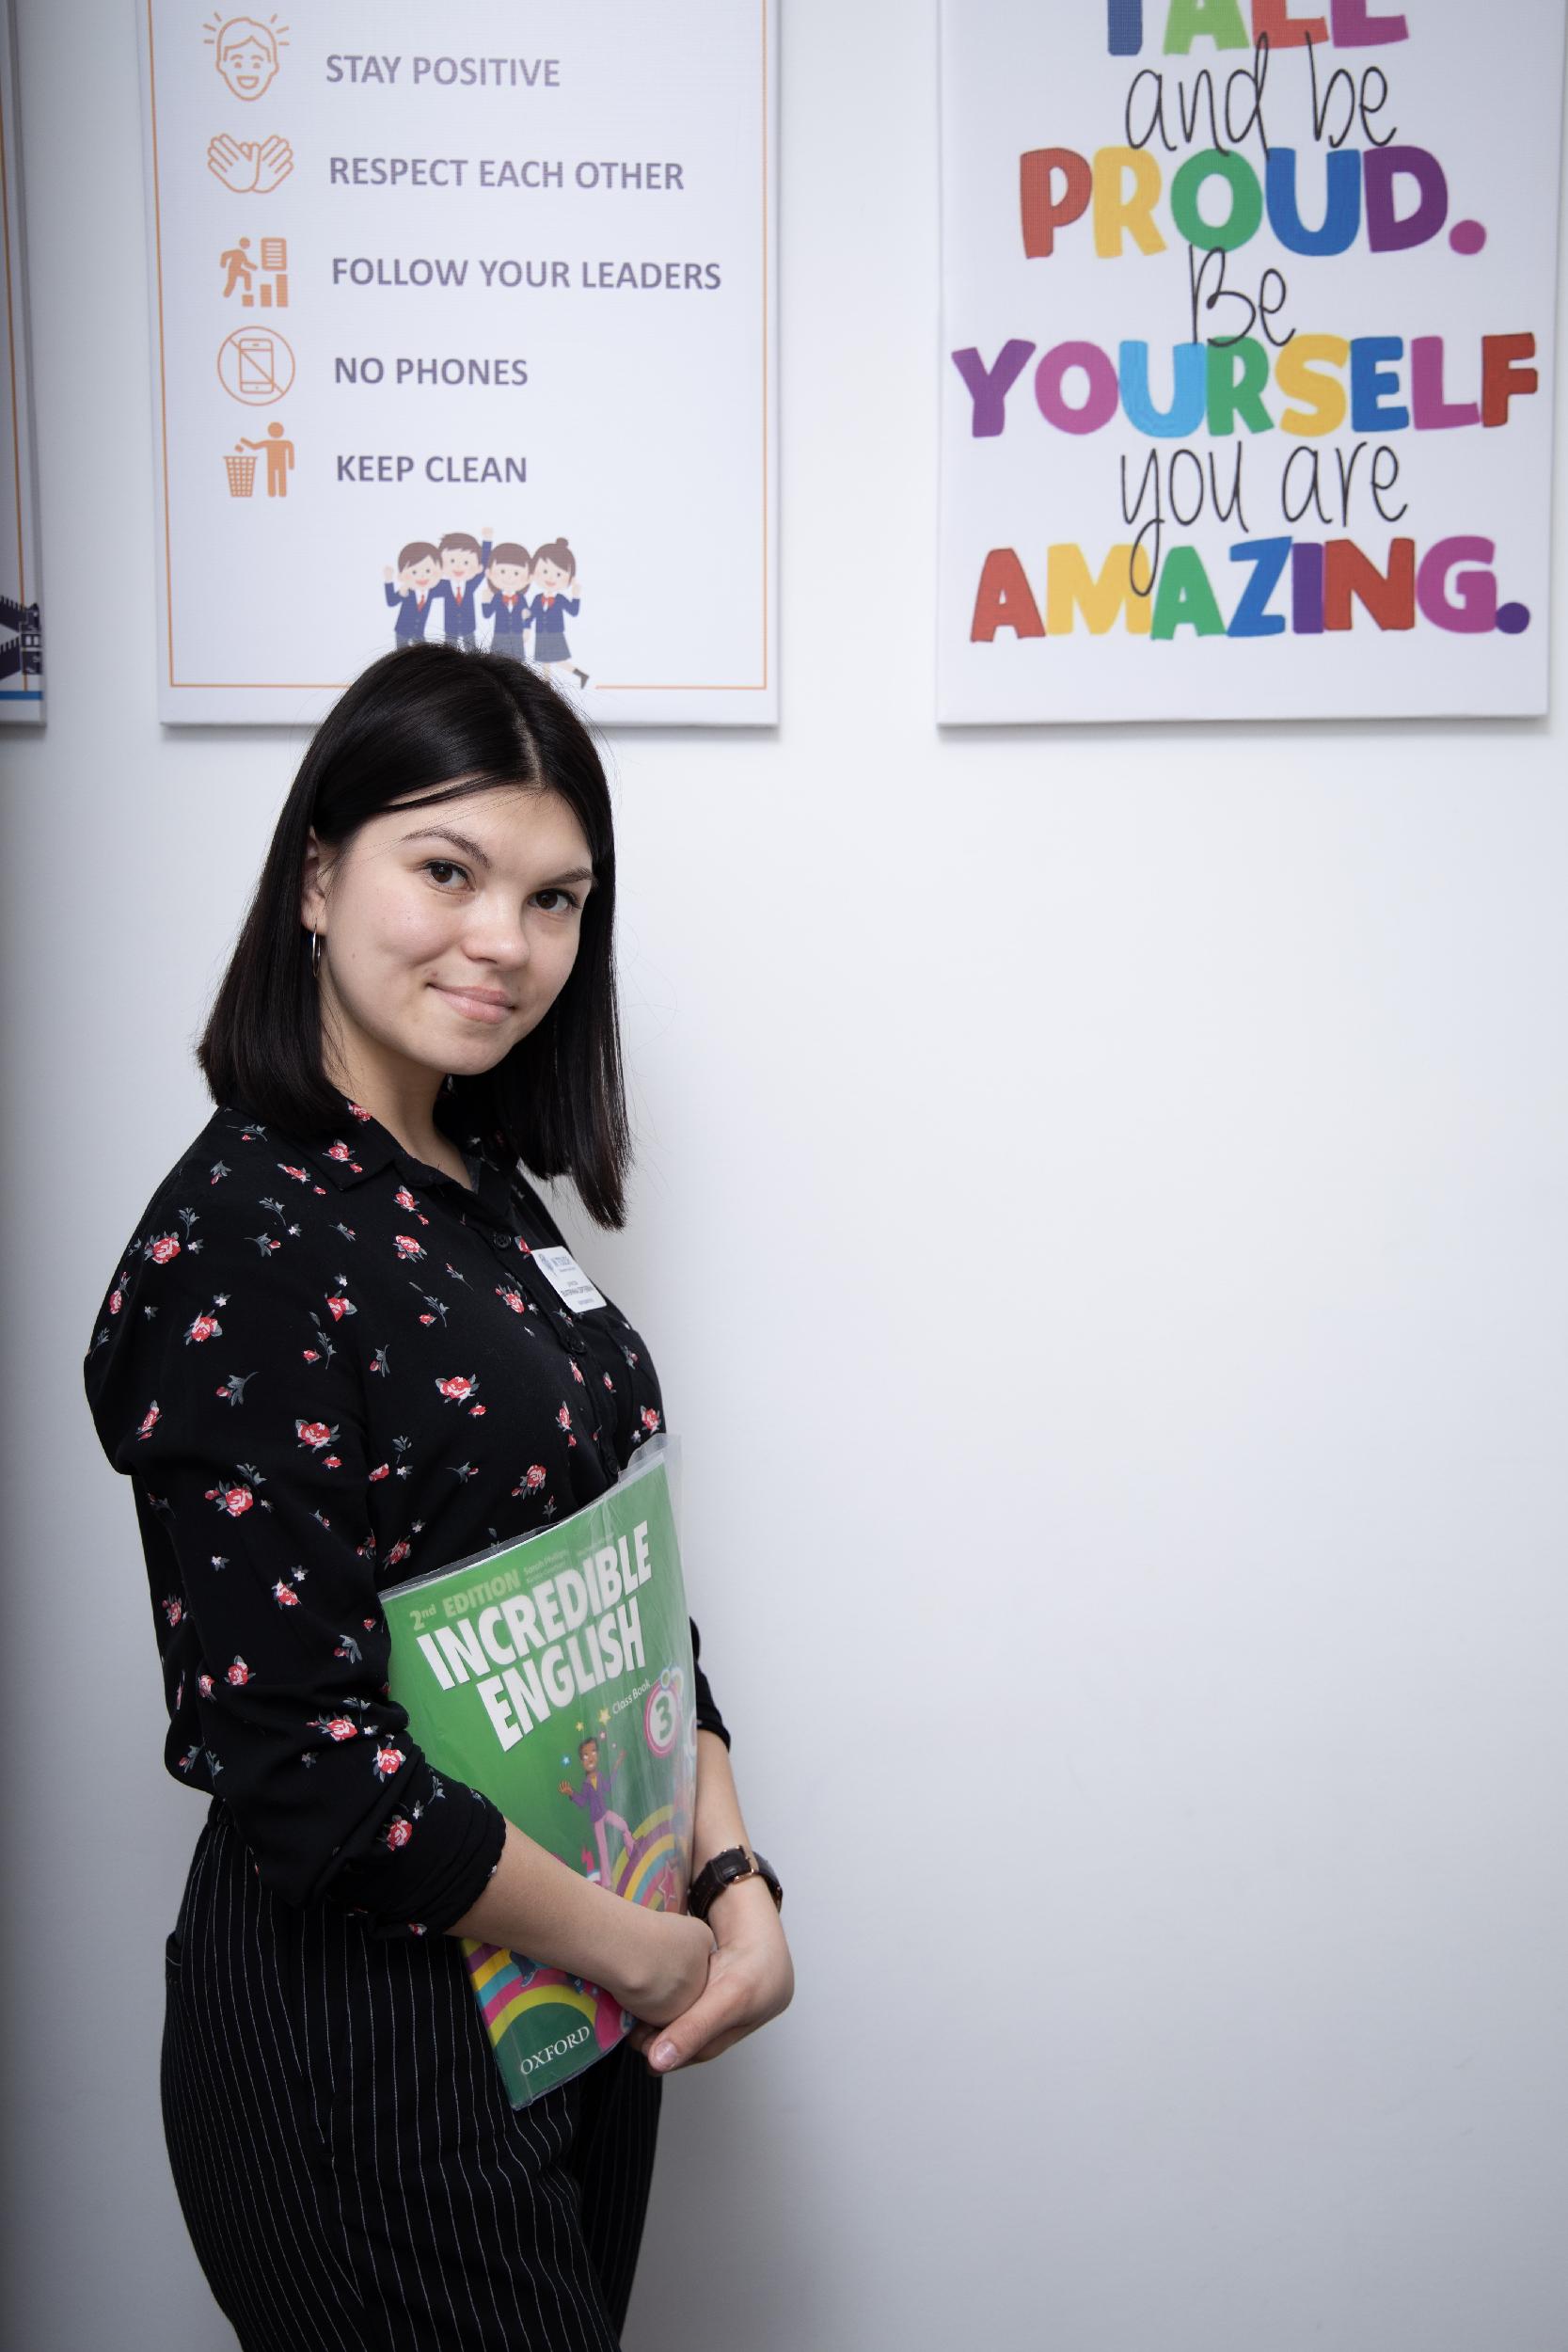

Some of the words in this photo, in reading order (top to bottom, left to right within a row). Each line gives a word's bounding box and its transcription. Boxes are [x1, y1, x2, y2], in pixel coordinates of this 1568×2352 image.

[326, 54, 402, 84] STAY
[413, 56, 560, 87] POSITIVE
[1126, 31, 1270, 162] and
[1304, 30, 1397, 148] be
[330, 157, 468, 186] RESPECT
[480, 160, 562, 188] EACH
[576, 162, 684, 190] OTHER
[1020, 146, 1487, 259] PROUD.
[332, 258, 468, 286] FOLLOW
[479, 260, 570, 288] YOUR
[582, 262, 721, 290] LEADERS
[1188, 245, 1296, 347] Be
[335, 357, 385, 385] NO
[396, 358, 528, 386] PHONES
[951, 332, 1538, 438] YOURSELF
[337, 454, 415, 483] KEEP
[425, 455, 527, 483] CLEAN
[1121, 440, 1249, 596] you
[1282, 441, 1408, 527] are
[970, 534, 1531, 643] AMAZING.
[409, 1603, 436, 1631] 2nd
[442, 1567, 521, 1618] EDITION
[416, 1520, 652, 1691] INCREDIBLE
[476, 1597, 645, 1753] ENGLISH
[612, 1694, 633, 1714] Class
[632, 1677, 651, 1699] Book
[656, 1695, 673, 1740] 3
[519, 2026, 591, 2075] OXFORD
